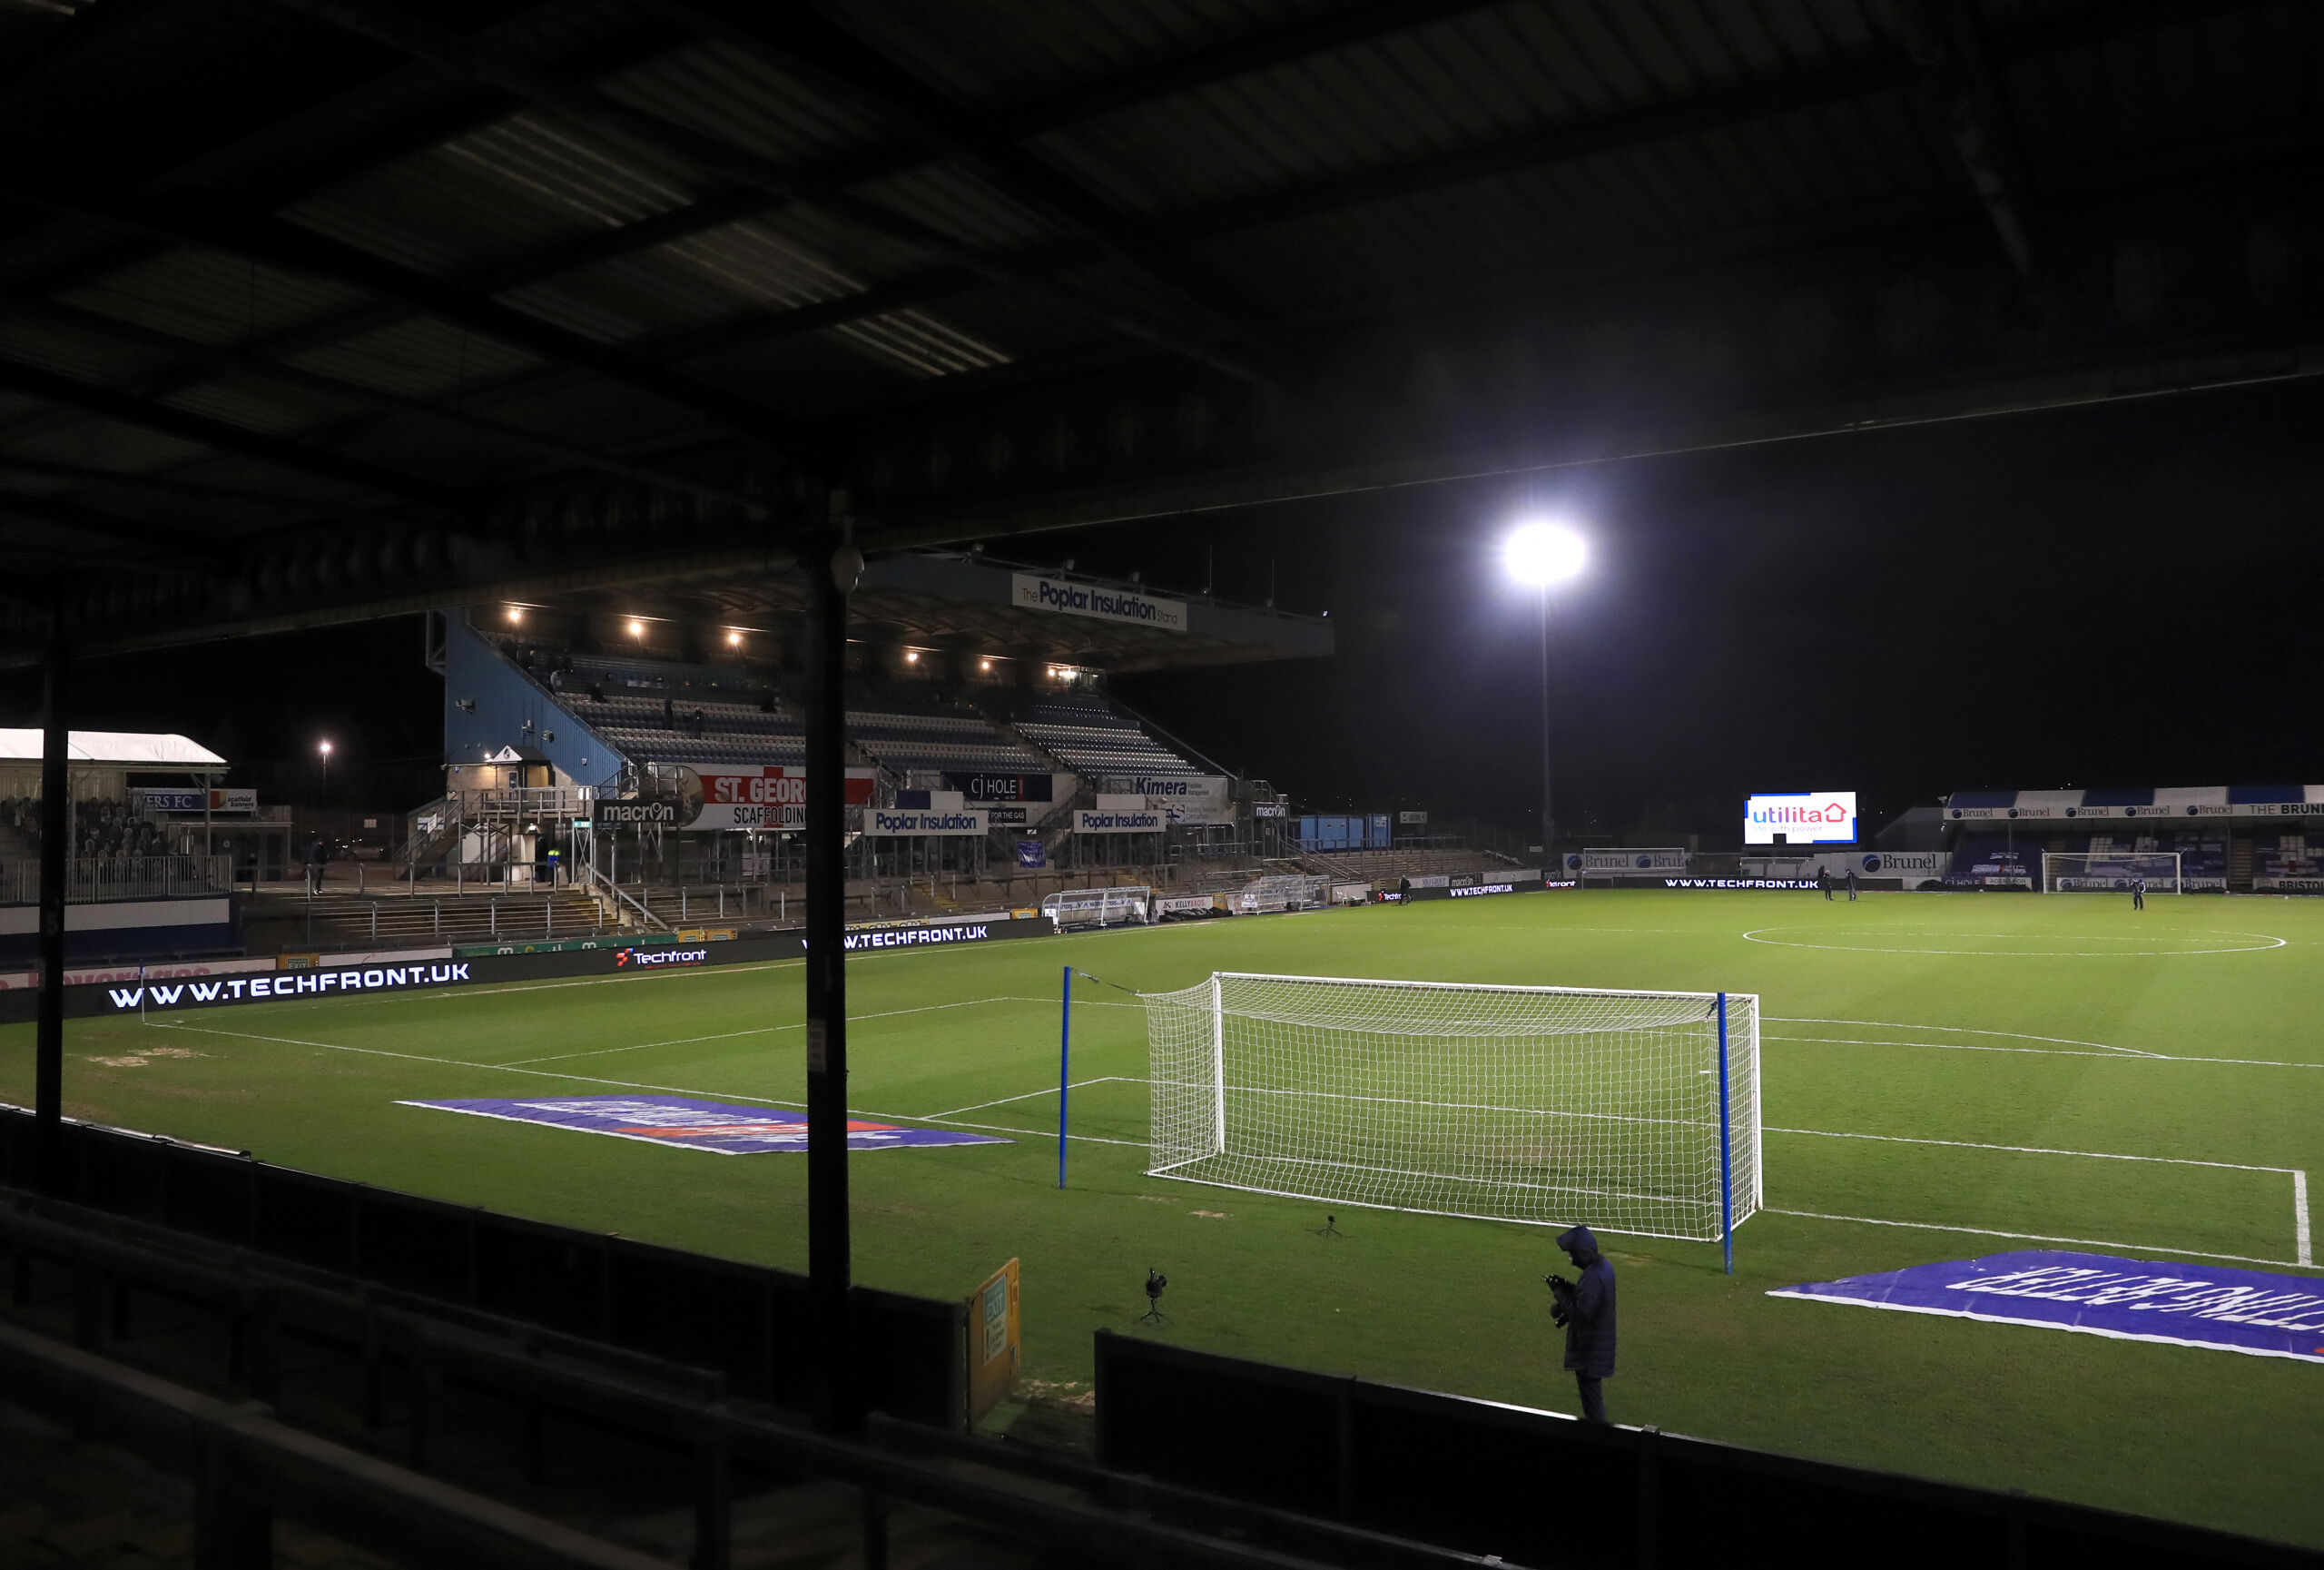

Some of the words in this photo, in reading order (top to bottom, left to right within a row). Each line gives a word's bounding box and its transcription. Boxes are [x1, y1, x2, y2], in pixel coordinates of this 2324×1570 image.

[1022, 588, 1038, 602] The
[1039, 580, 1088, 611] Poplar
[1091, 589, 1156, 620] Insulation
[1157, 610, 1177, 625] Stand
[714, 776, 745, 804] ST.
[750, 777, 806, 803] GEOR
[987, 779, 1017, 794] HOLE
[1136, 777, 1187, 795] Kimera
[174, 795, 193, 808] FC
[604, 801, 675, 822] macron
[734, 806, 806, 824] SCAFFOLDIN
[1014, 812, 1024, 820] GAS
[1256, 805, 1285, 817] macron
[1753, 806, 1823, 824] utilita
[1963, 808, 1993, 817] Brunel
[2019, 807, 2050, 817] Brunel
[2077, 807, 2109, 816] Brunel
[2137, 805, 2170, 815] Brunel
[2199, 805, 2233, 815] Brunel
[2246, 805, 2275, 815] THE
[2281, 804, 2324, 815] BRUN
[876, 813, 918, 834] Poplar
[921, 813, 976, 830] Insulation
[1082, 814, 1114, 832] Poplar
[1116, 814, 1157, 828] Insulation
[1585, 854, 1630, 868] Brunel
[1883, 854, 1937, 869] Brunel
[1450, 884, 1513, 897] WWW.TECHFRONT.UK
[1665, 879, 1819, 889] WWW.TECHFRONT.UK
[803, 925, 988, 950] W.TECHFRONT.UK
[633, 949, 707, 964] Techfront
[108, 963, 470, 1009] WWW.TECHFRONT.UK
